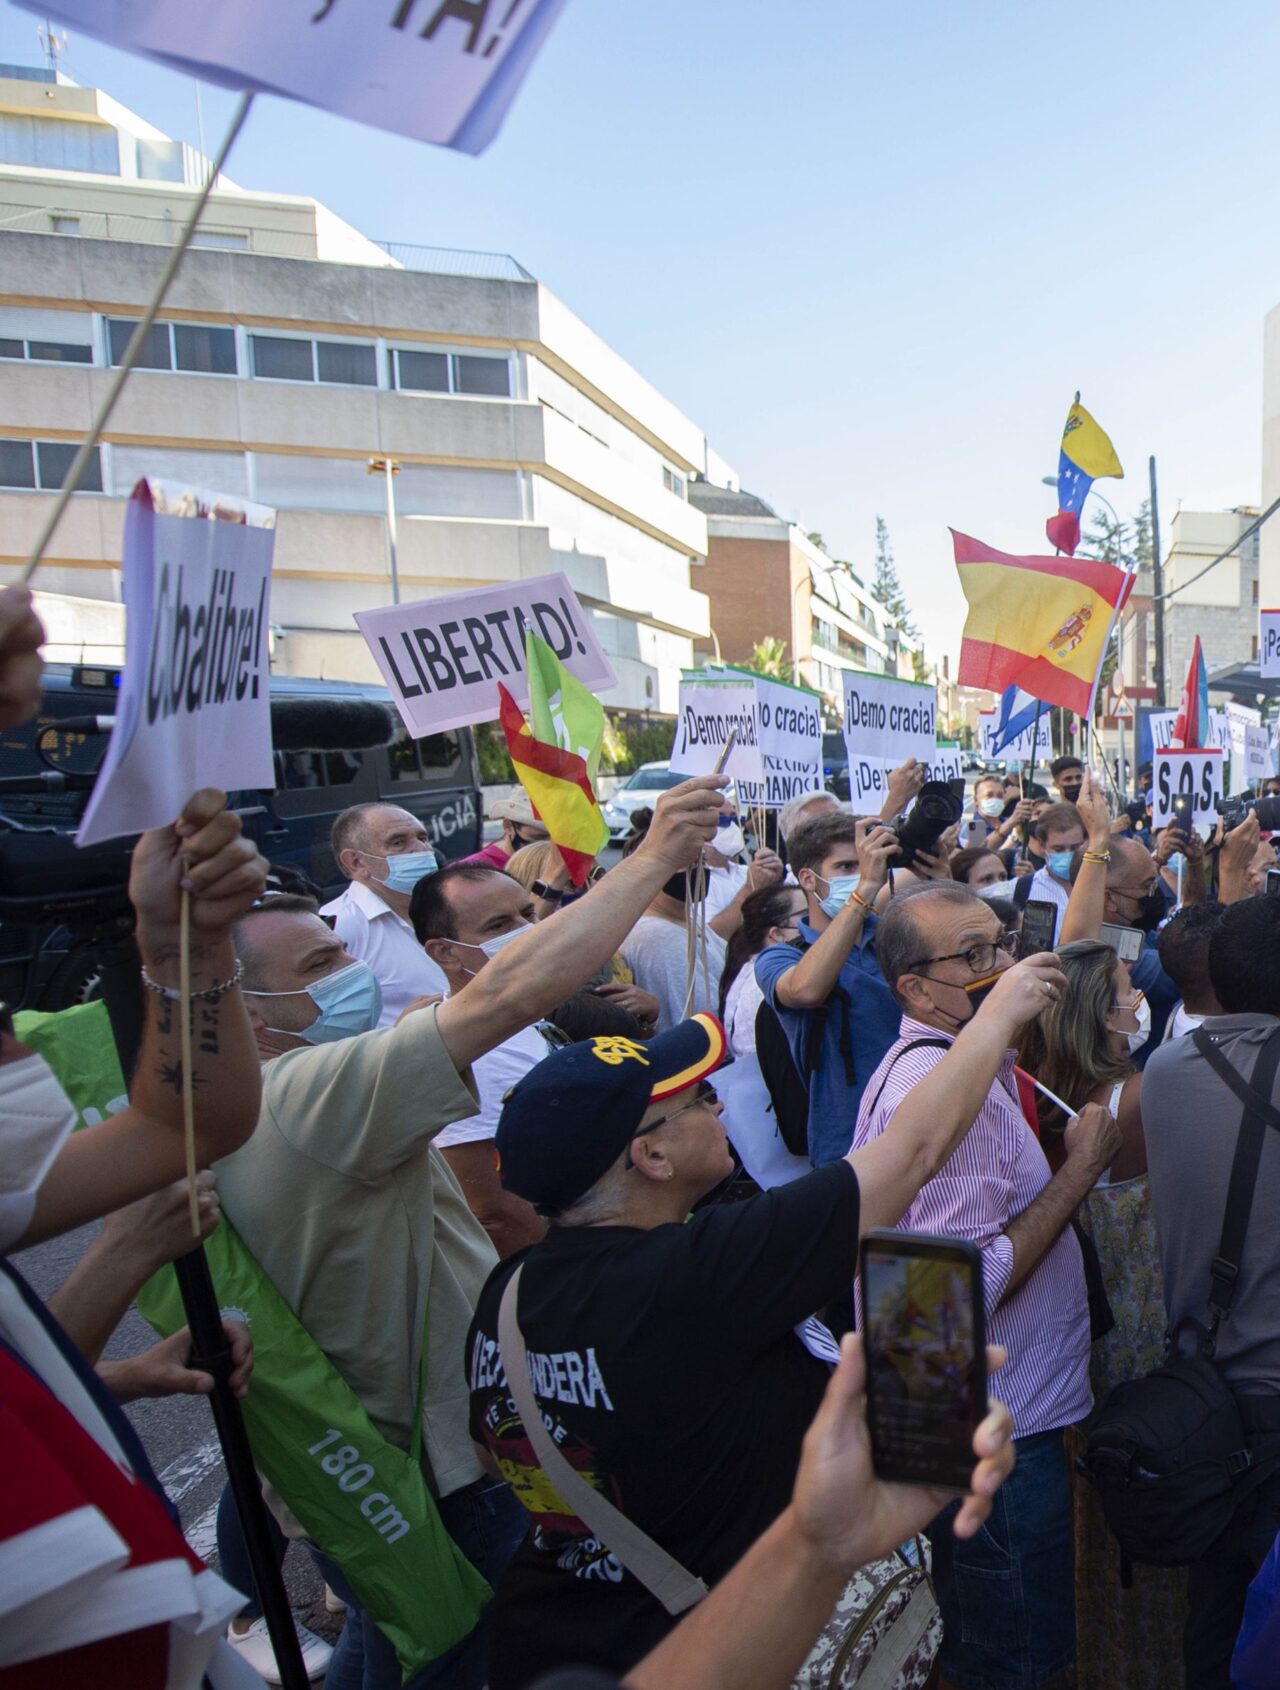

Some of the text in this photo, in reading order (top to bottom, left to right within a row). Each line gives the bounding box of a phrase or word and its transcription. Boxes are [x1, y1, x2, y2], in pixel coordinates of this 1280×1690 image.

[682, 704, 726, 755] ¡Demo
[775, 705, 821, 739] cracia!
[847, 690, 935, 736] ¡Demo cracia!
[1026, 725, 1050, 747] Vda!
[1158, 761, 1220, 815] S.O.S.
[308, 1428, 411, 1544] 180 cm
